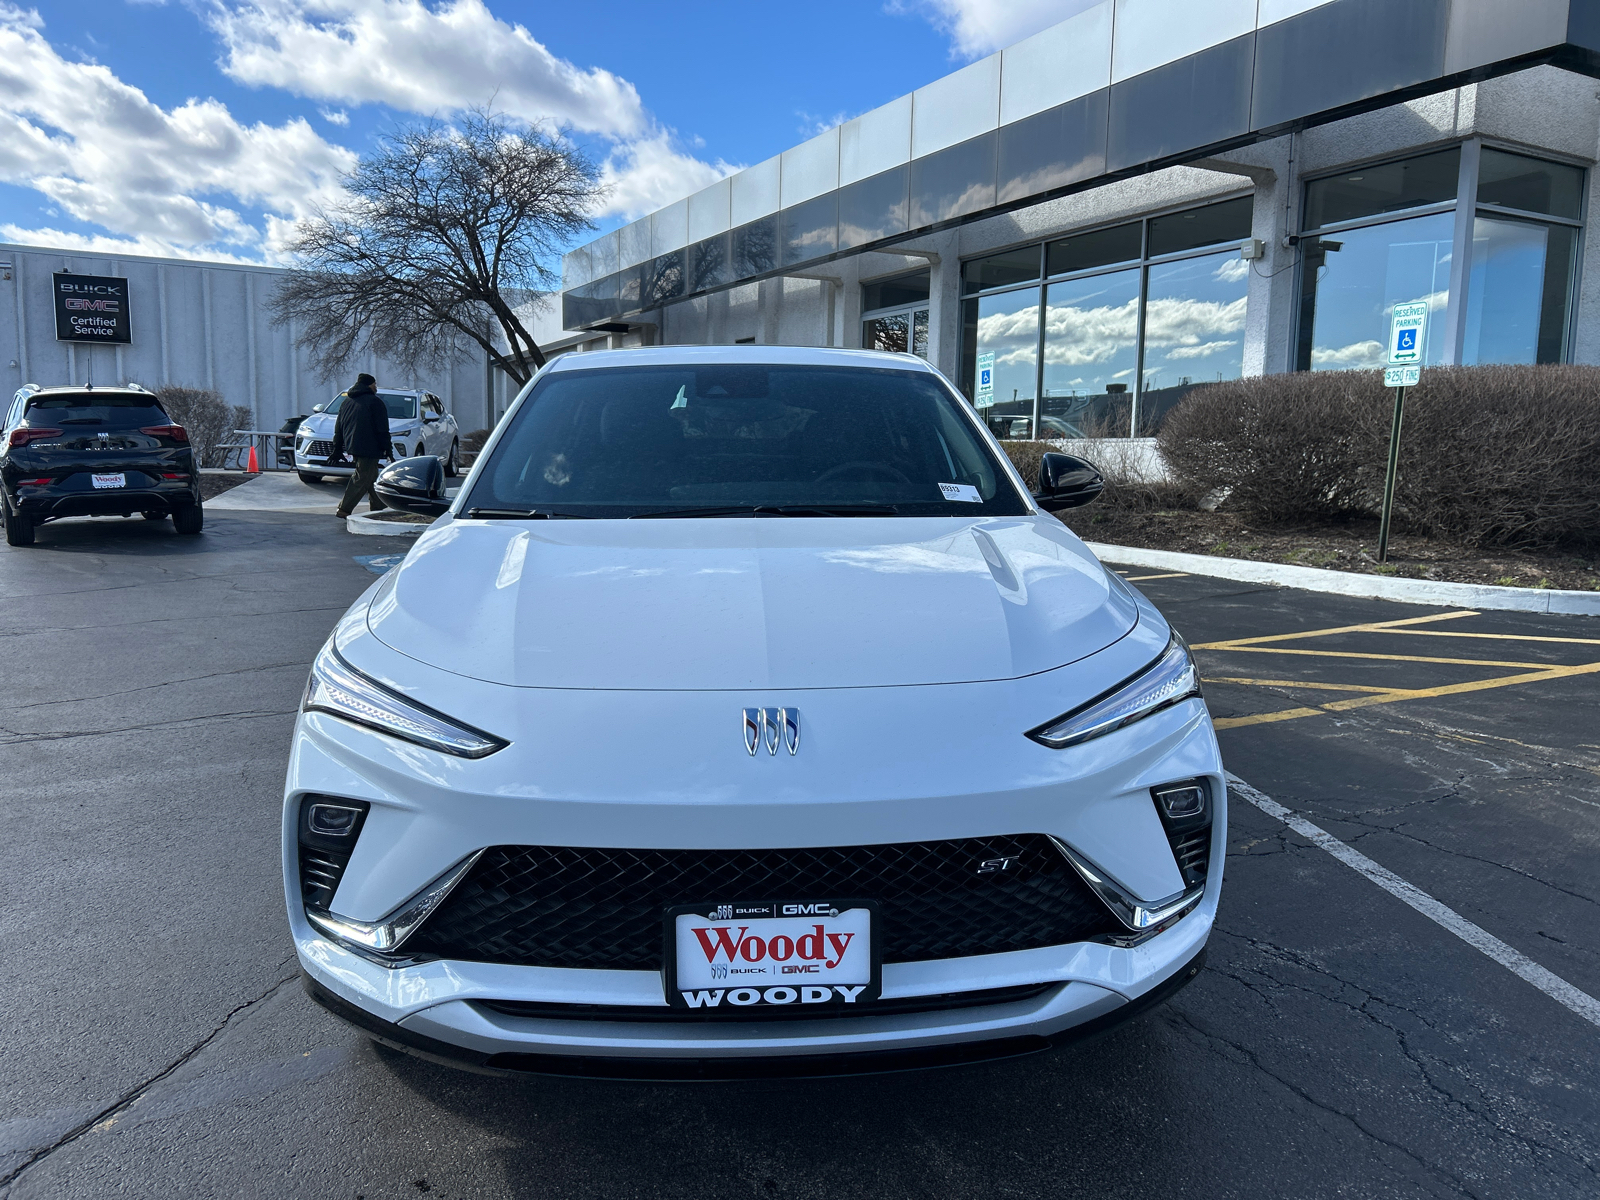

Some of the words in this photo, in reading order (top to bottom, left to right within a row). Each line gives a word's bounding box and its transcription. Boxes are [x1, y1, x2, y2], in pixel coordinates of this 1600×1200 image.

[60, 283, 121, 296] BUICK
[65, 298, 119, 312] GMC
[1395, 306, 1425, 318] RESERVED
[70, 316, 117, 327] Certified
[1396, 318, 1422, 328] PARKING
[74, 325, 114, 336] Service
[1405, 369, 1418, 382] FINE
[94, 475, 123, 483] Woody
[977, 855, 1020, 874] ST
[782, 903, 830, 915] GMC
[690, 924, 855, 969] Woody
[781, 964, 820, 975] GMC
[681, 985, 867, 1009] WOODY
